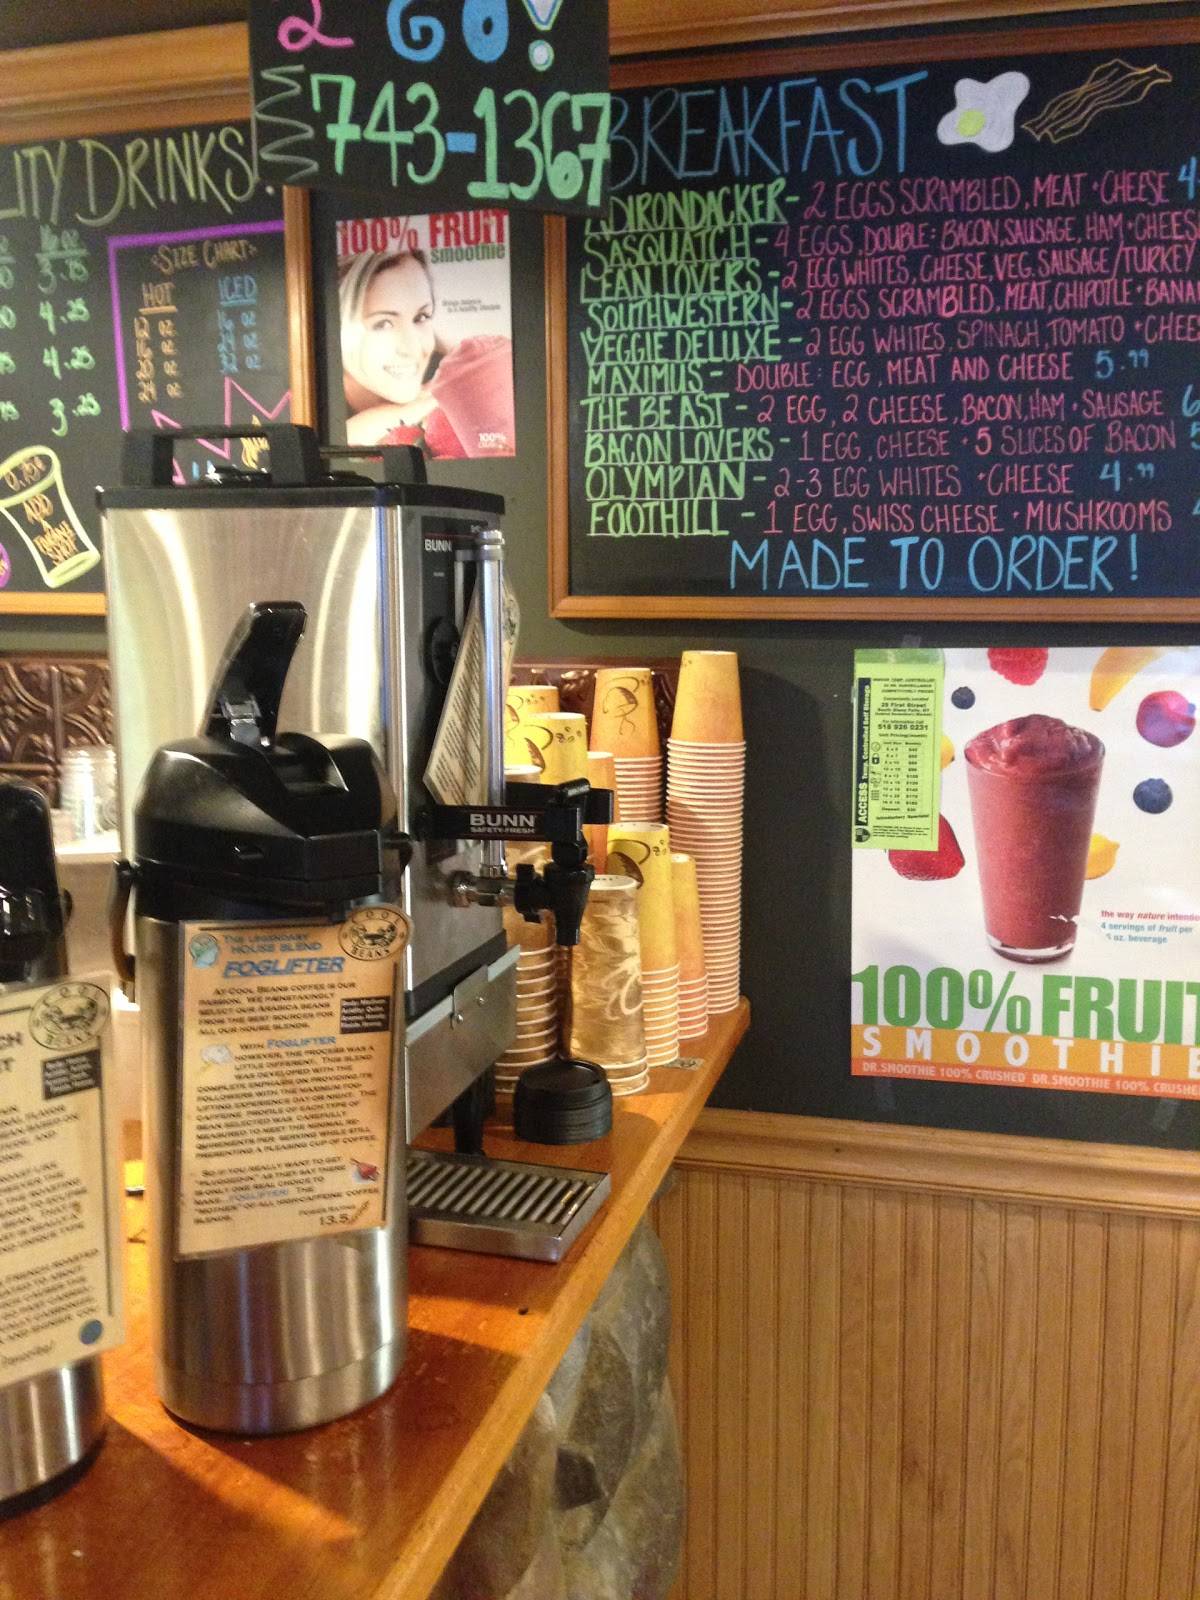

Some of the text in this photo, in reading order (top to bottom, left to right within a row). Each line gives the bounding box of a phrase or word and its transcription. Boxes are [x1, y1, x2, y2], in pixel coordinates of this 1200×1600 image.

[310, 73, 611, 206] 743-1367
[609, 70, 928, 191] BREAKFAST
[804, 181, 826, 219] 2
[835, 180, 895, 219] EGGS
[1032, 173, 1088, 208] MEAT
[337, 209, 509, 256] 100% FRUIT
[584, 225, 750, 281] SASQUATCH
[774, 226, 789, 256] 4
[1086, 212, 1123, 241] HAM
[1135, 210, 1200, 242] CHEES
[430, 244, 506, 264] smoothie
[141, 281, 176, 307] HOT
[581, 265, 649, 303] LEAN
[662, 258, 762, 300] LOVERS
[782, 260, 797, 289] 2
[807, 257, 838, 288] EGG
[796, 290, 814, 320] 2
[820, 288, 870, 320] EGGS
[1055, 276, 1132, 309] CHIPOTLE
[1145, 277, 1200, 306] BANA
[580, 331, 668, 365] VEGGIE
[675, 325, 782, 364] DELUXE
[806, 325, 821, 356] 2
[829, 325, 865, 356] EGG
[1047, 315, 1125, 347] TOMATO
[1144, 311, 1200, 344] CHEE
[587, 361, 704, 396] MAXIMUS
[886, 354, 942, 385] MEAT
[951, 354, 990, 381] AND
[998, 352, 1074, 381] CHEESE
[580, 394, 632, 430] THE
[639, 393, 729, 429] BEAST
[757, 394, 775, 423] 2
[843, 394, 859, 422] 2
[1029, 389, 1065, 421] HAM
[1082, 389, 1164, 420] SAUSAGE
[585, 431, 671, 467] BACON
[680, 427, 774, 464] LOVERS
[799, 431, 814, 462] 1
[877, 430, 950, 460] CHEESE
[975, 427, 992, 455] 5
[1001, 425, 1066, 456] SLICES
[1068, 424, 1096, 452] OF
[1105, 420, 1176, 454] BACON
[586, 462, 745, 500] OLYMPIAN
[833, 467, 870, 498] EGG
[879, 465, 962, 497] WHITES
[987, 463, 1075, 496] CHEESE
[590, 498, 729, 537] FOOTHILL
[763, 501, 783, 533] 1
[853, 503, 915, 533] SWISS
[920, 504, 1004, 533] CHEESE
[1025, 500, 1172, 532] MUSHROOMS
[425, 539, 452, 552] BUNN
[730, 533, 1138, 592] MADE TO ORDER!
[470, 814, 535, 827] BUNN
[858, 782, 868, 823] ACCESS
[1101, 910, 1114, 918] the
[1117, 911, 1135, 920] way
[1137, 912, 1166, 920] nature
[1108, 923, 1145, 932] servings
[1159, 925, 1178, 933] fruit
[1179, 926, 1193, 935] per
[1128, 934, 1168, 945] beverage
[222, 957, 345, 978] FOGLIFTER
[852, 964, 1031, 1036] 100%
[880, 1063, 936, 1077] SMOOTHIE
[940, 1068, 973, 1080] 100%
[976, 1070, 1026, 1083] CRUSHED
[1052, 1075, 1111, 1090] SMOOTHIE
[1115, 1081, 1151, 1093] 100%
[1153, 1082, 1200, 1097] CRUSHE
